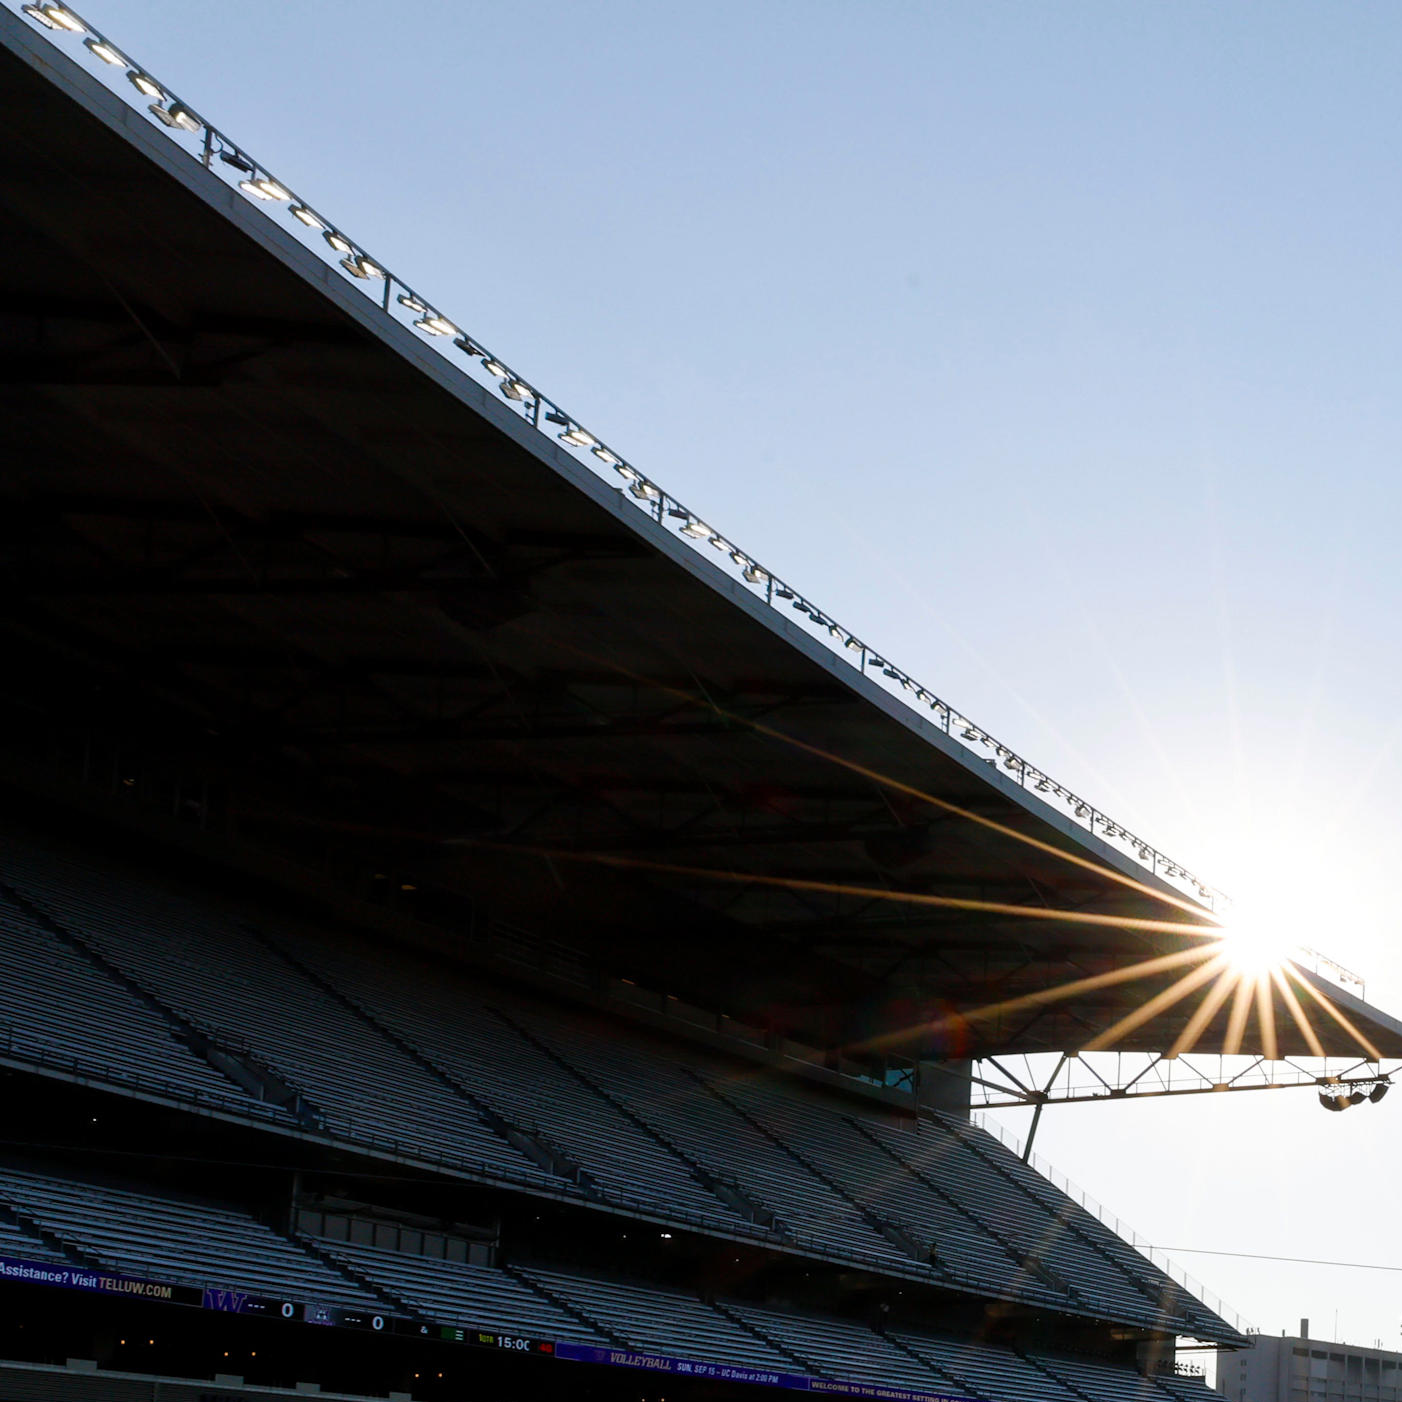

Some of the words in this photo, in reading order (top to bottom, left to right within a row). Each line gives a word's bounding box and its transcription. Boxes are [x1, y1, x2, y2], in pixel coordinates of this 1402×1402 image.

[71, 1272, 97, 1288] Visit
[99, 1277, 172, 1299] TELLUW.COM
[281, 1302, 294, 1318] 0
[371, 1315, 385, 1331] 0
[609, 1351, 672, 1371] VOLLEYBALL
[811, 1381, 849, 1393] WELCOME
[850, 1385, 860, 1395] TO
[861, 1387, 875, 1396] THE
[876, 1388, 911, 1400] GREATEST
